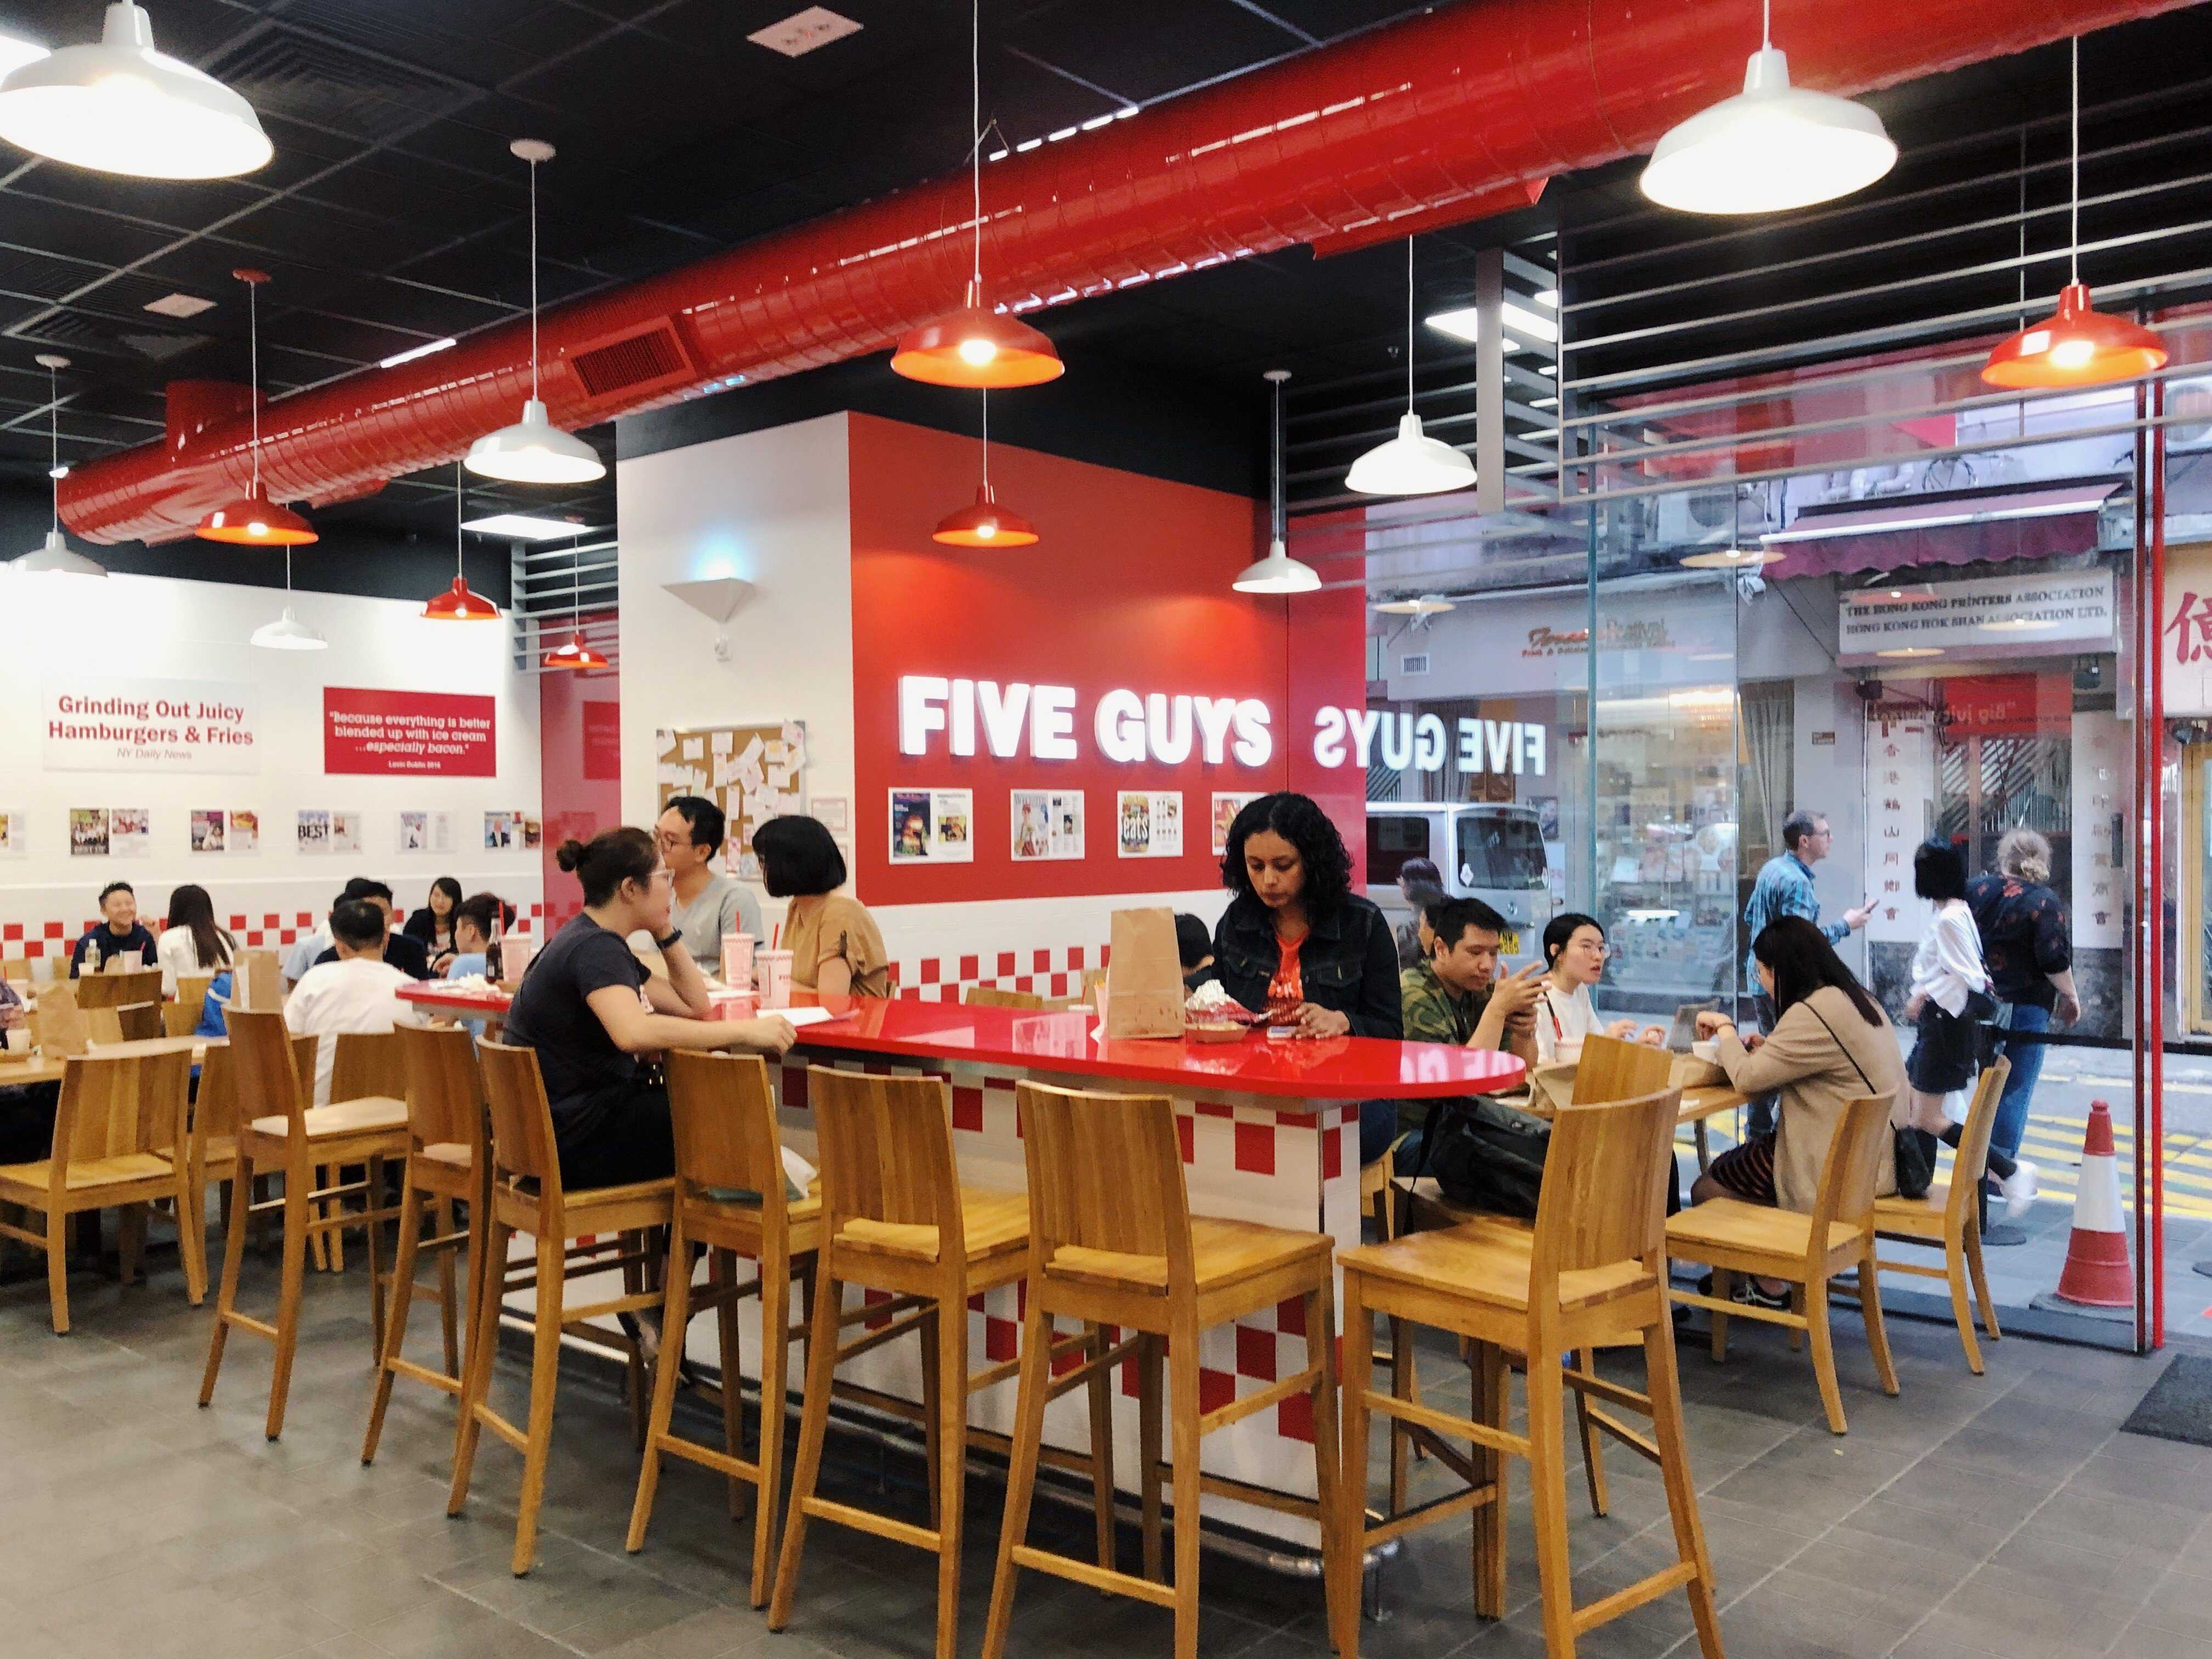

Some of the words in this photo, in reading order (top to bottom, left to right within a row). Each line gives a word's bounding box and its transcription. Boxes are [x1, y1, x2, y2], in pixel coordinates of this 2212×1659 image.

[1846, 605, 1870, 617] THE
[1874, 602, 1908, 615] HONG
[1911, 598, 1948, 612] KONG
[1950, 594, 2012, 608] PRINTERS
[2016, 586, 2104, 603] ASSOCIATION
[1846, 623, 1881, 635] HONG
[1883, 619, 1918, 632] KONG
[1921, 617, 1949, 629] HOK
[1951, 614, 1984, 628] SHAN
[1988, 606, 2074, 624] AOCIATION
[58, 695, 149, 720] Grinding
[155, 700, 190, 718] Out
[196, 702, 244, 724] Juicy
[386, 715, 445, 729] everything
[448, 716, 456, 727] is
[459, 717, 491, 729] better
[899, 675, 1077, 760] FIVE
[1095, 689, 1272, 767] GUYS
[48, 721, 178, 746] Hamburgers
[184, 725, 201, 744] &
[207, 727, 254, 745] Fries
[335, 726, 384, 738] blended
[387, 729, 403, 741] up
[406, 729, 430, 741] with
[432, 730, 449, 741] ice
[452, 731, 487, 742] cream
[117, 748, 132, 759] NY
[135, 748, 161, 760] Daily
[164, 749, 193, 760] News
[297, 823, 330, 839] BEST
